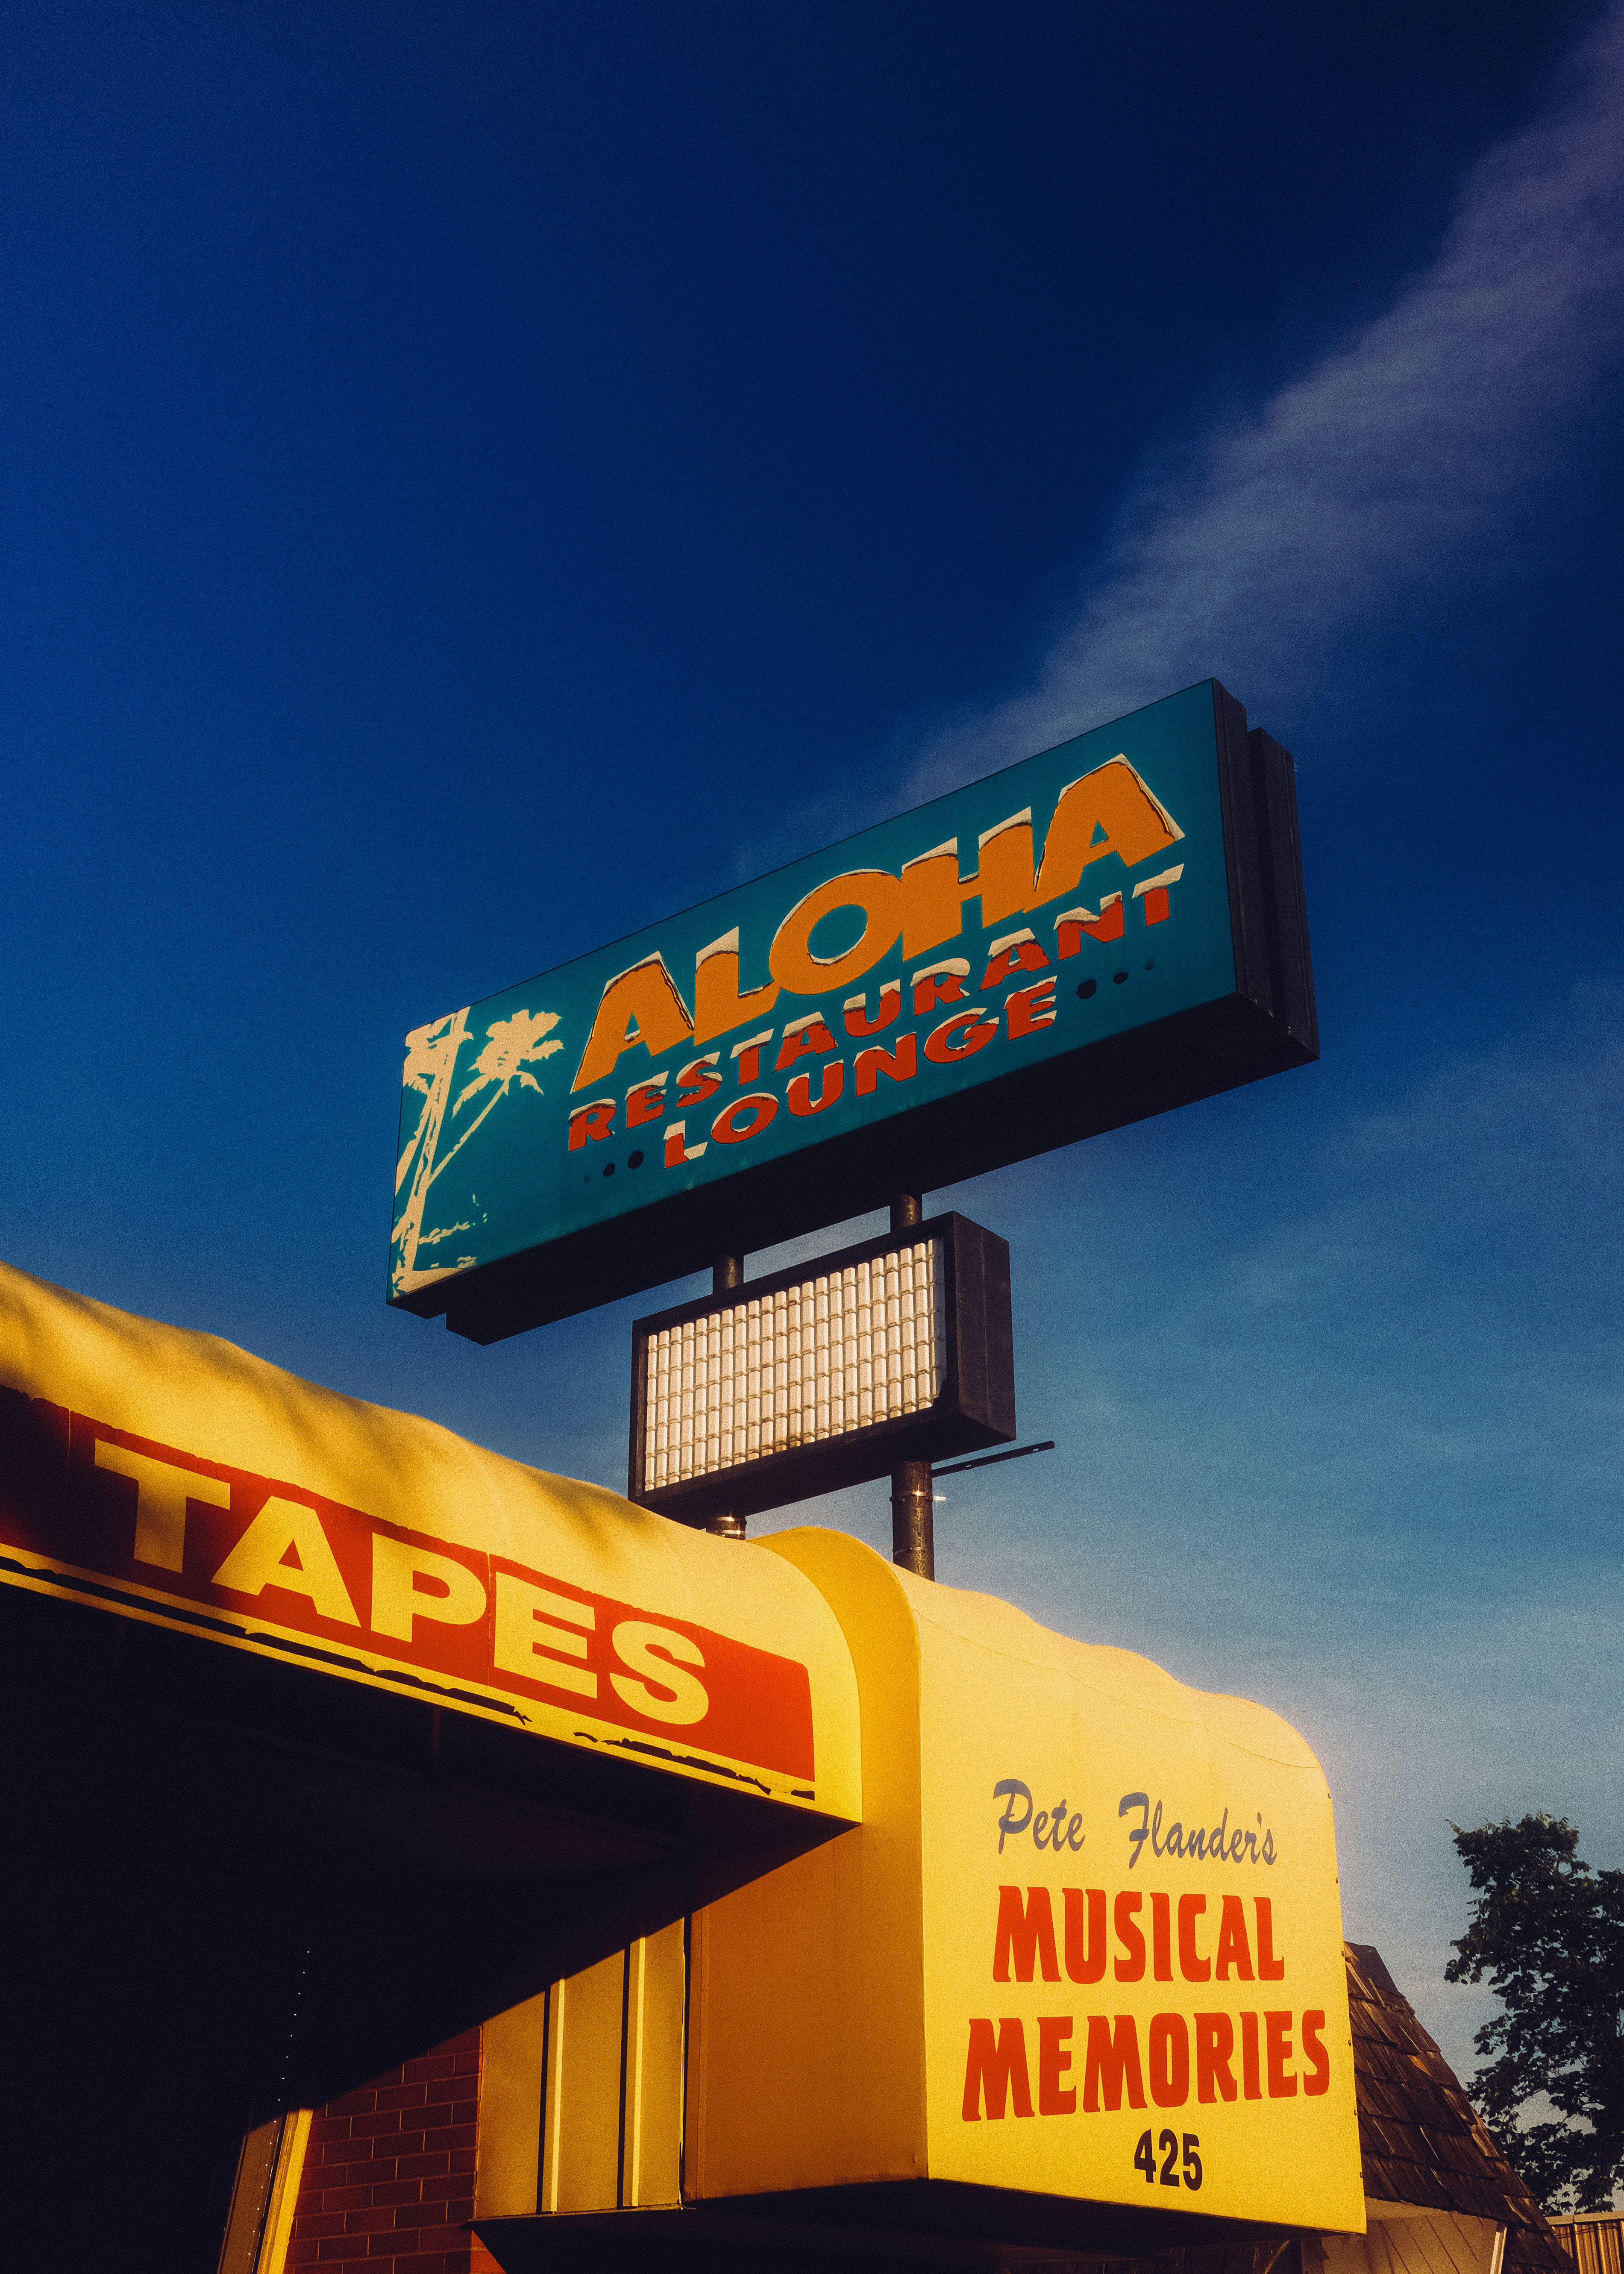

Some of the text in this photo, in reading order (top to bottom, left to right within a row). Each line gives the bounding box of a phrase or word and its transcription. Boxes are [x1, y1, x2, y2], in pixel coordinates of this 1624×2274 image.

[571, 753, 1184, 1094] ALOHA
[568, 864, 1184, 1151] RESTAURANT
[664, 977, 1059, 1168] LOUNGE
[94, 1438, 709, 1725] TAPES
[993, 1779, 1277, 1869] Pete Flander's
[993, 1885, 1284, 1984] MUSICAL
[962, 2010, 1330, 2121] MEMORIES
[1134, 2128, 1203, 2191] 425
